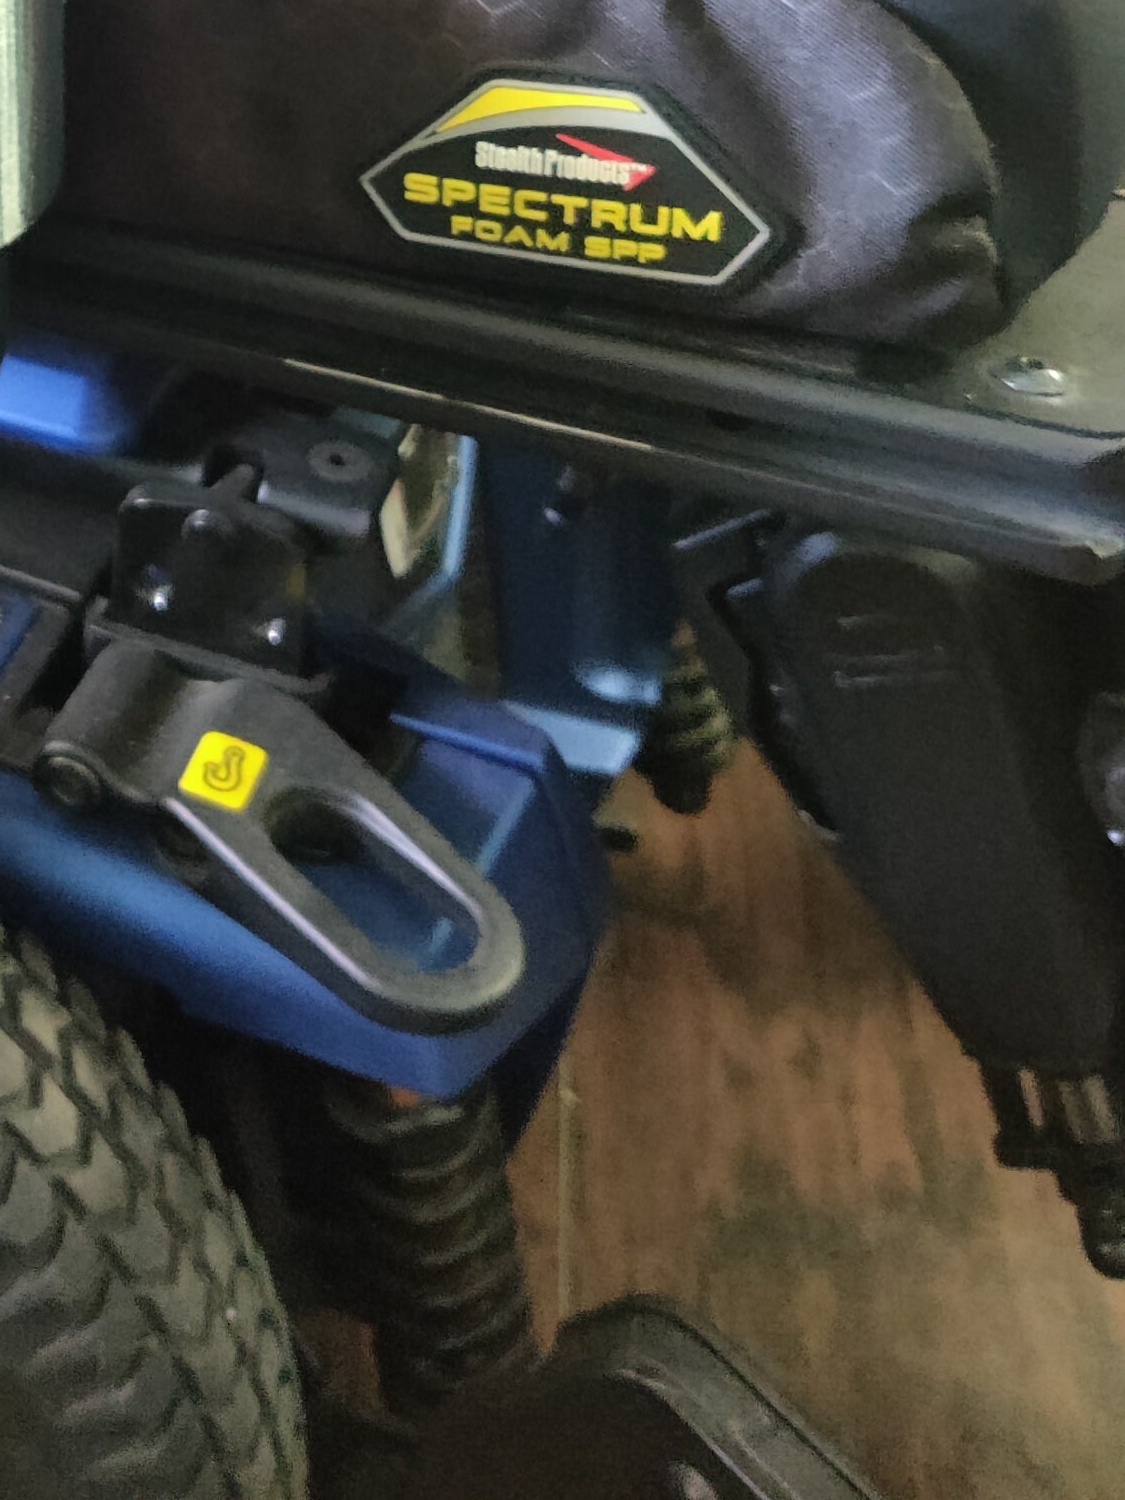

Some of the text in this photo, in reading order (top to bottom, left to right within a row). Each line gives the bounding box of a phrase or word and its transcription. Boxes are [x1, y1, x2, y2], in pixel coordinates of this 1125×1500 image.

[475, 140, 544, 177] Stealth
[403, 171, 724, 243] SPECTRUM
[450, 215, 667, 264] FOAM SPP
